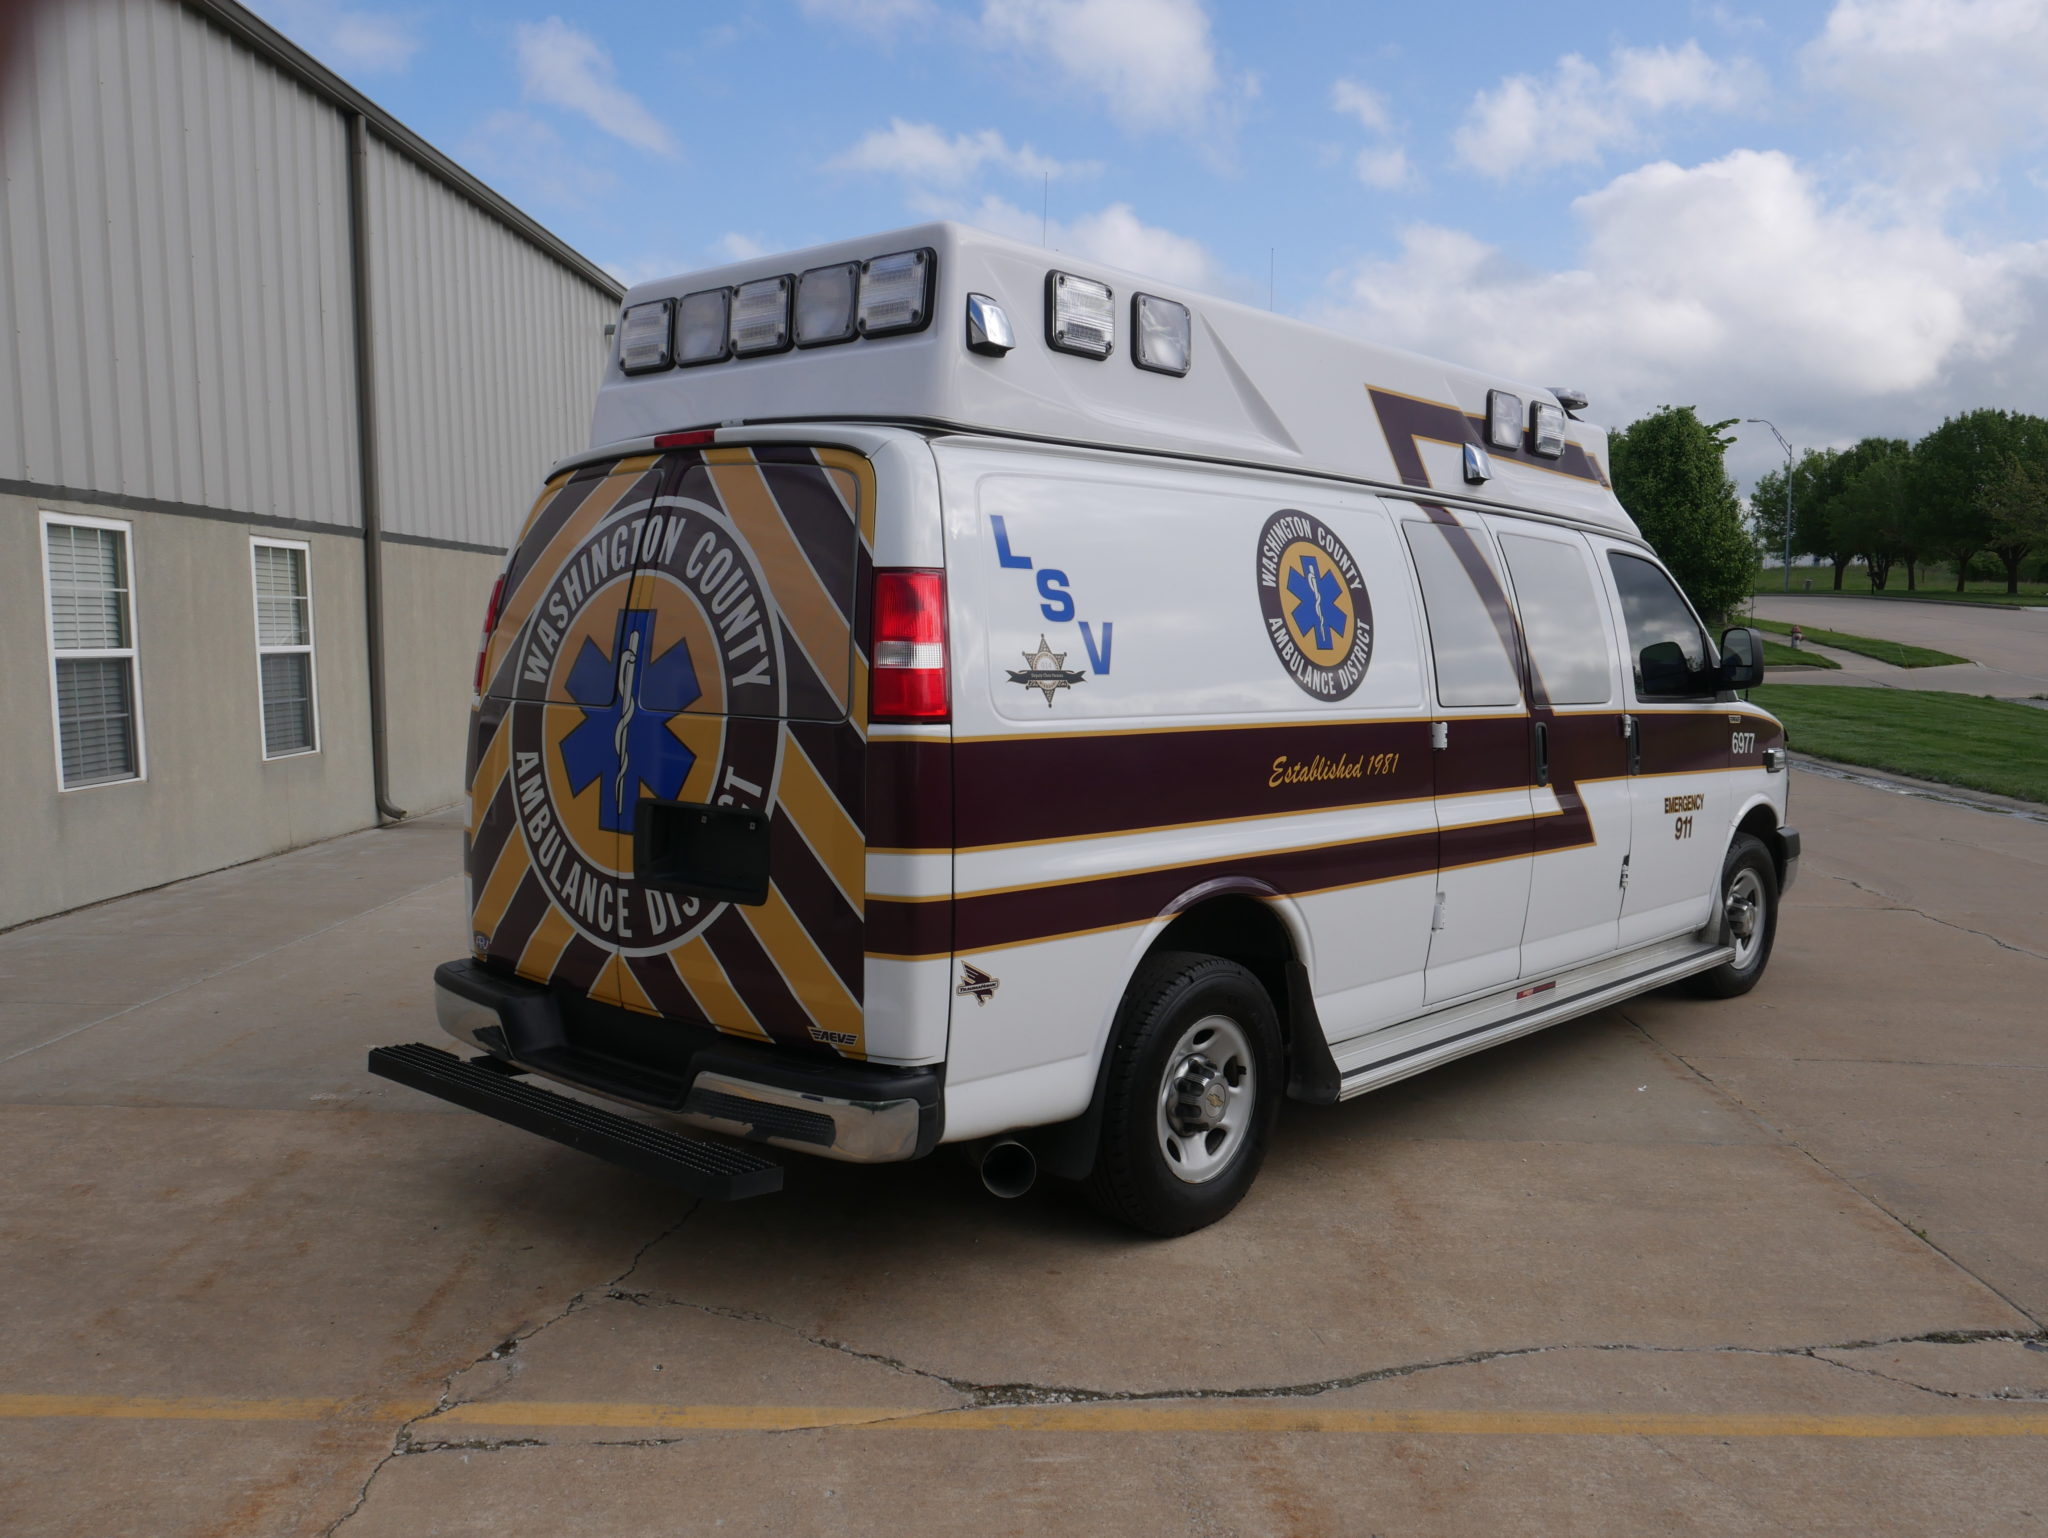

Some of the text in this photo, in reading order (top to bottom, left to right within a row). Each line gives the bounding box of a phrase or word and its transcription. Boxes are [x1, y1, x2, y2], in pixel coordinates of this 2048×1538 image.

[1262, 516, 1363, 589] WASHINGTON COUNTY
[523, 513, 772, 689] WASHINGTON COUNTY
[1268, 617, 1370, 695] AMBULANCE DISTRICT
[1731, 731, 1755, 754] 6977
[1268, 753, 1400, 788] Established 1981
[1664, 793, 1704, 814] EMERGENCY
[1674, 816, 1693, 840] 911
[516, 751, 763, 938] AMBULANCE DIST
